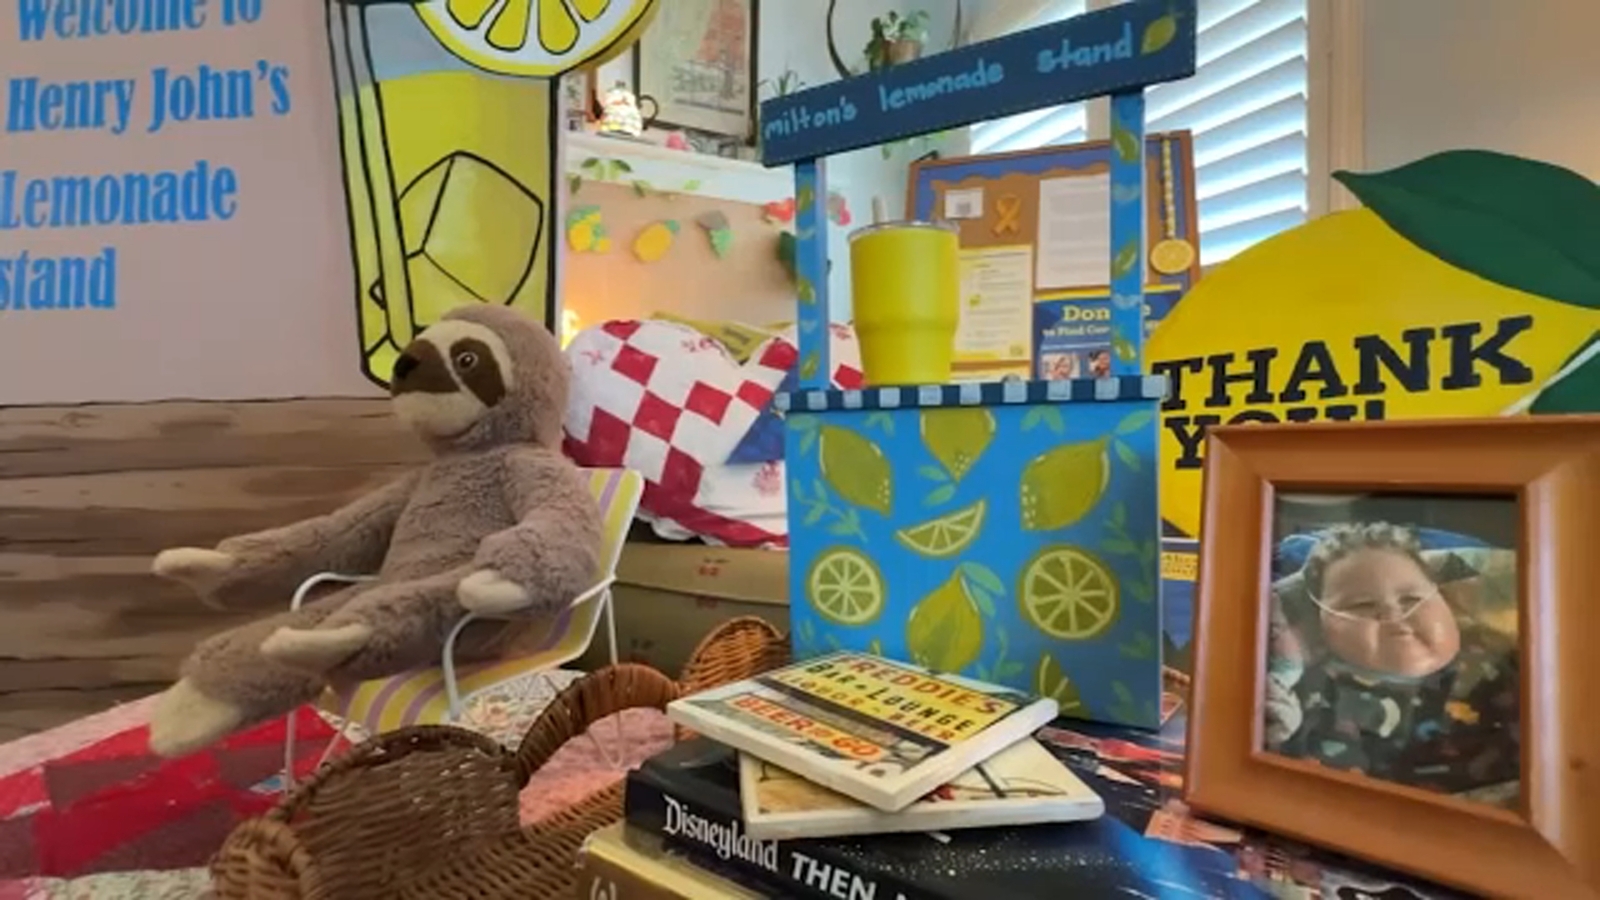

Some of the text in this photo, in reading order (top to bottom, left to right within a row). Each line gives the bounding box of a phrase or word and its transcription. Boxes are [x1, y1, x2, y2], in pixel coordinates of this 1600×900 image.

[18, 0, 207, 41] Welcome
[6, 76, 136, 136] Henry
[763, 21, 1133, 141] milton's lemonade stand
[0, 160, 238, 230] Lemonade
[0, 247, 117, 310] stand
[1151, 315, 1534, 413] THANK
[734, 696, 814, 732] BEER
[831, 736, 882, 758] GO
[866, 686, 979, 732] LOUNGE
[661, 794, 876, 900] Disneyland THEN
